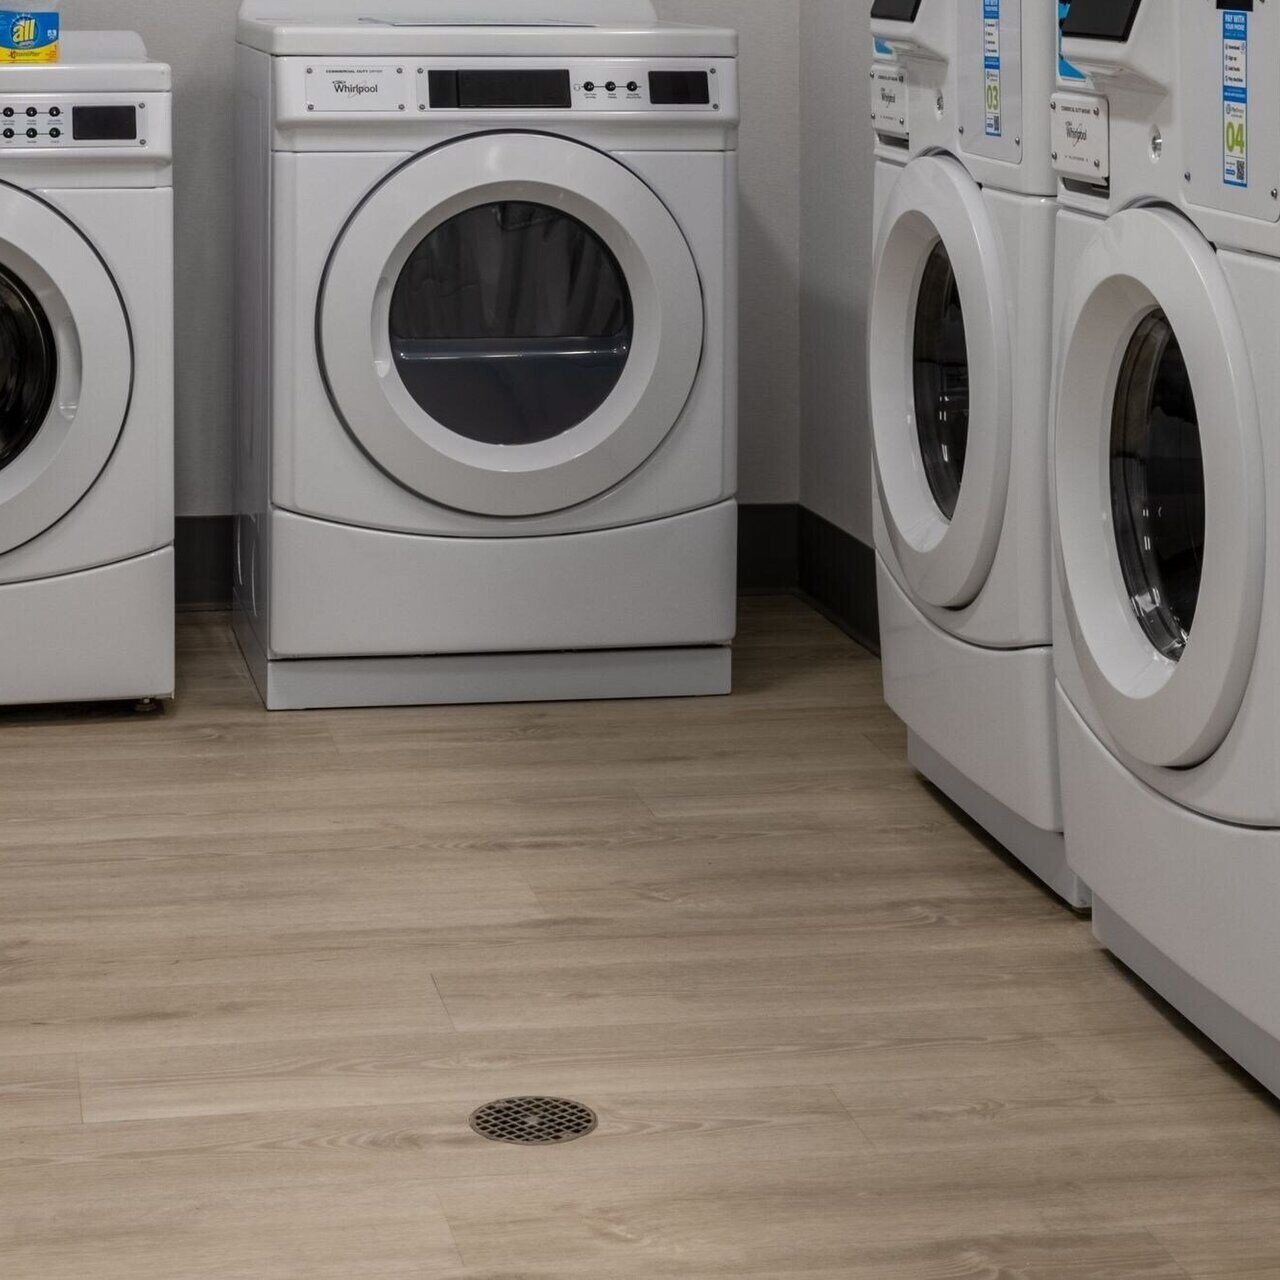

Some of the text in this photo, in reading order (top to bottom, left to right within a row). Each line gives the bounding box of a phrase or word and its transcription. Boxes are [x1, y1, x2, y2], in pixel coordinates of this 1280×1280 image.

[12, 19, 36, 43] all
[333, 84, 378, 95] Whirlpool
[1226, 121, 1245, 154] 04
